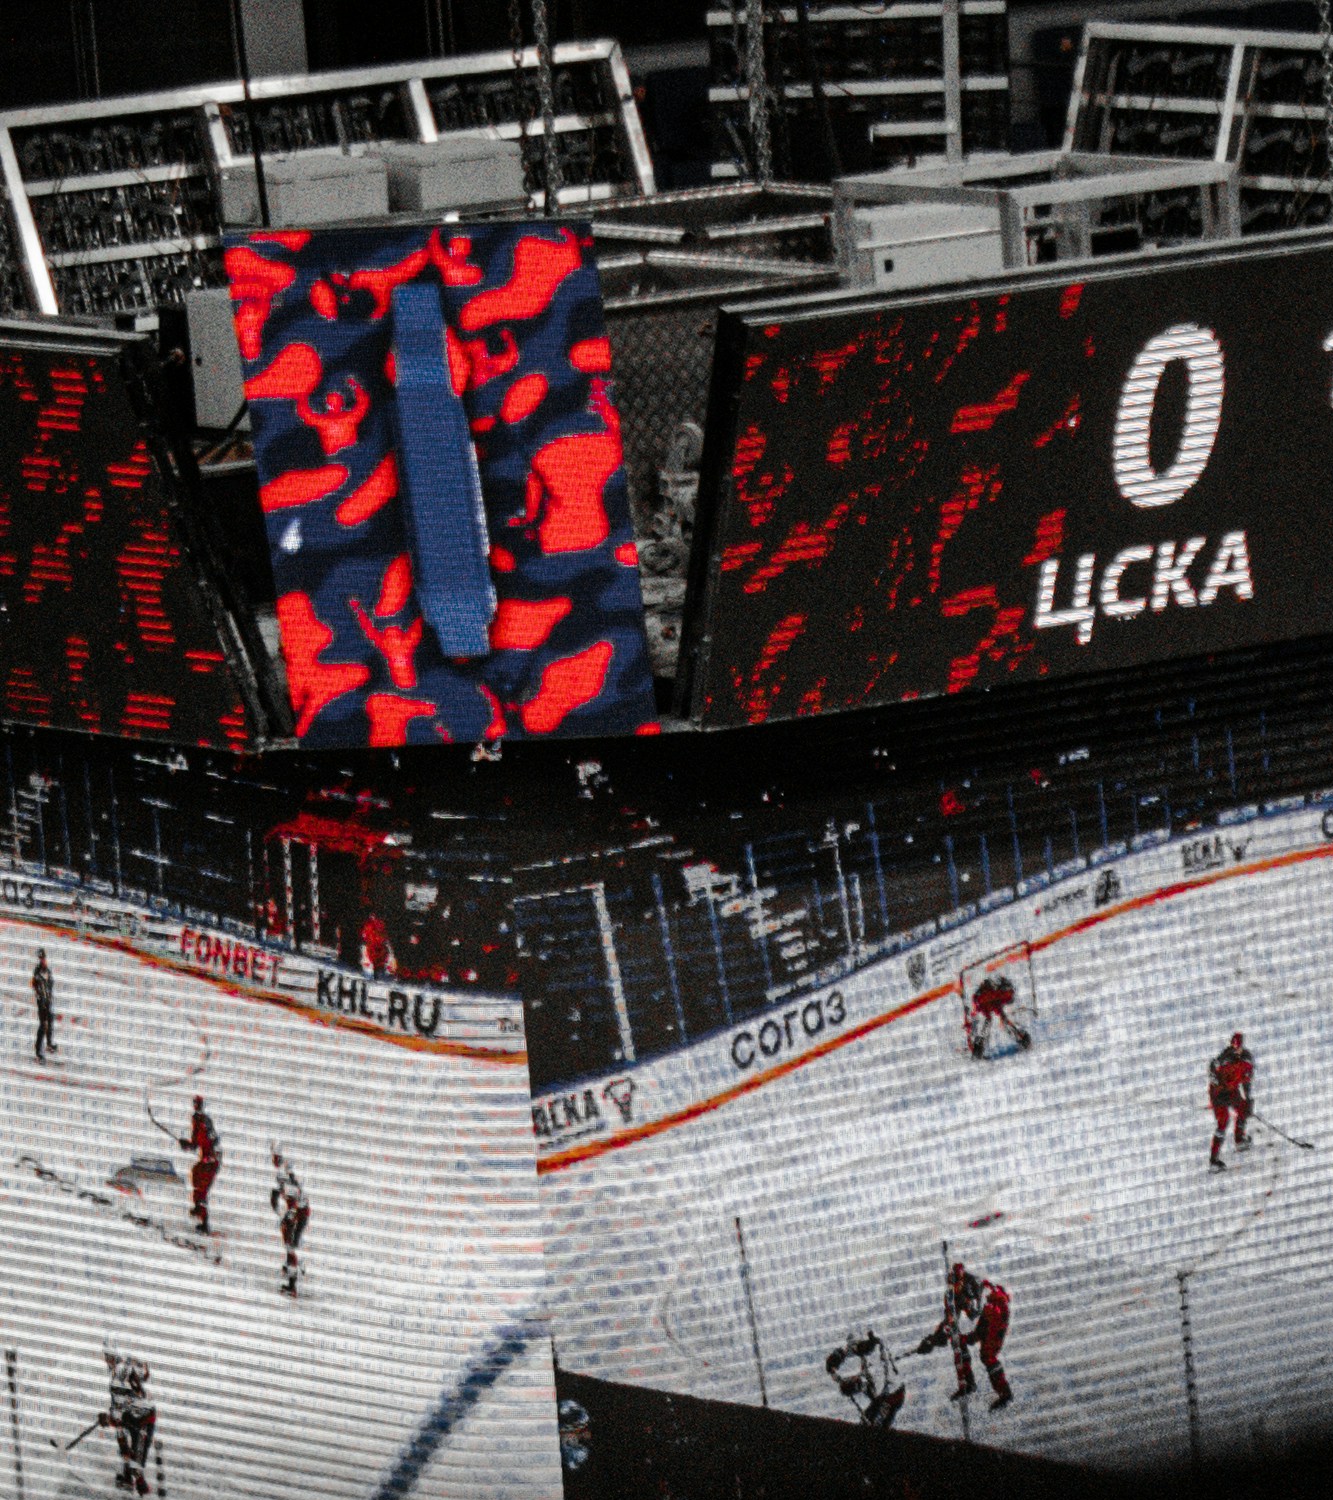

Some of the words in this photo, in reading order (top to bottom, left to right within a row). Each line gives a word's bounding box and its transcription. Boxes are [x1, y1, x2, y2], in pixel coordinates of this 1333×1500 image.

[1112, 323, 1224, 507] 0
[1033, 530, 1254, 644] ЦСКА
[181, 925, 284, 988] FONBET
[317, 968, 442, 1036] KHL.RU
